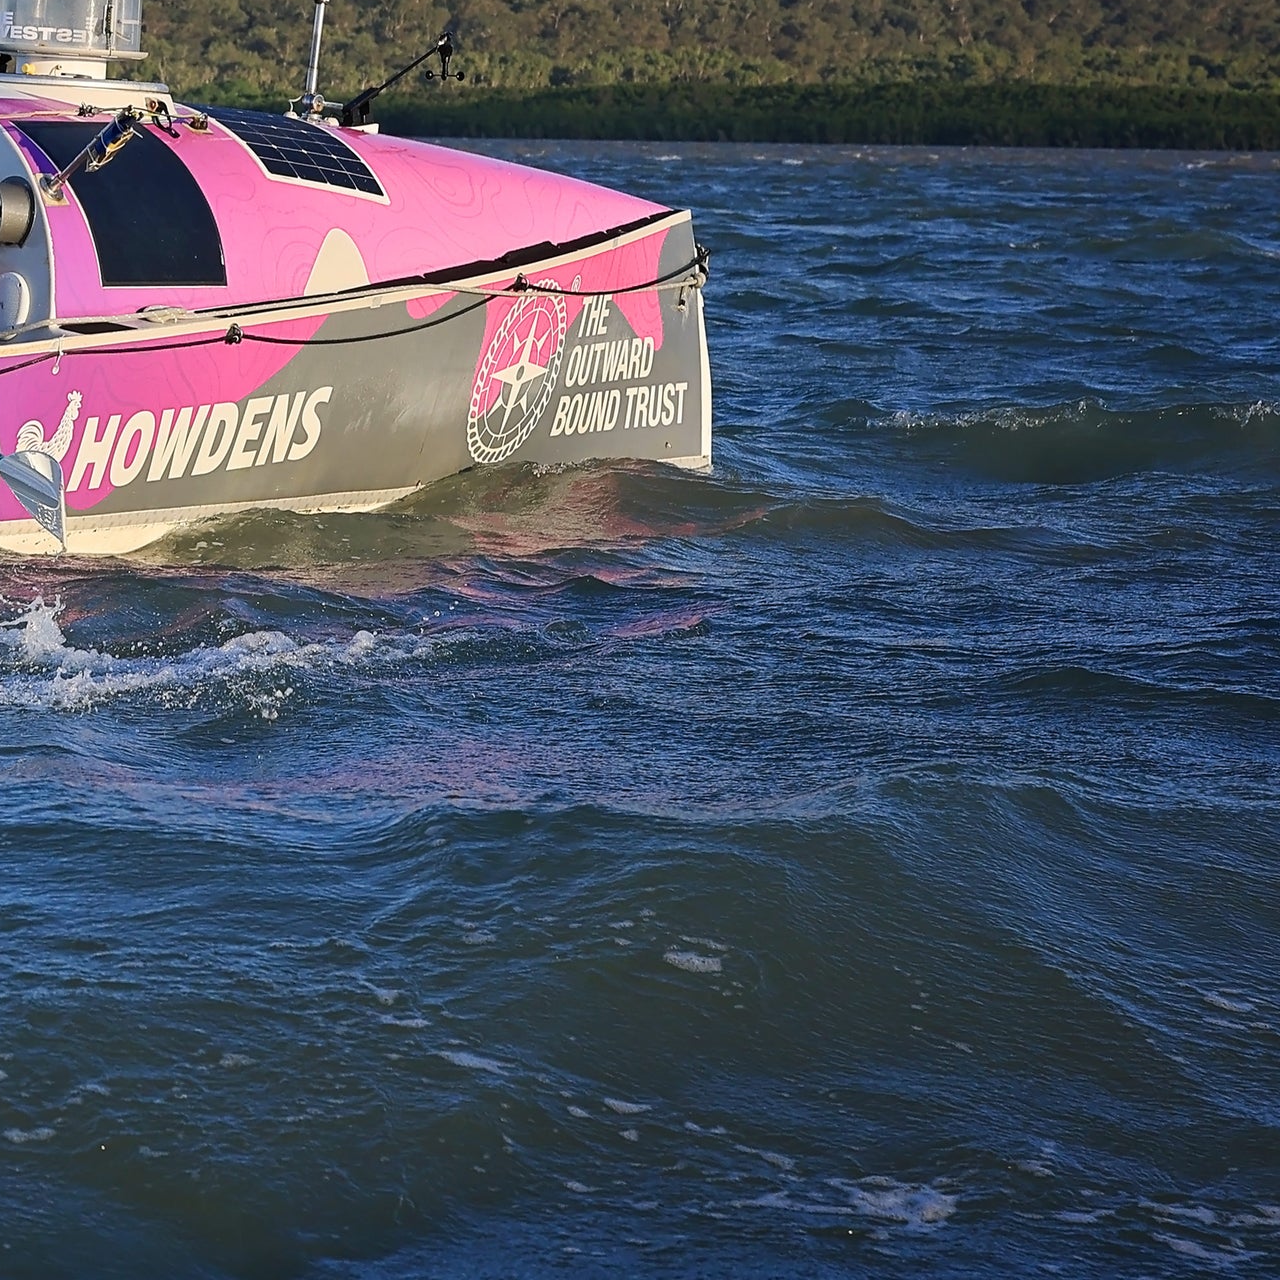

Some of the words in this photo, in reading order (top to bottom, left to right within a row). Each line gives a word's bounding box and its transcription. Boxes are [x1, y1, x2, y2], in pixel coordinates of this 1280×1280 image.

[578, 294, 613, 338] THE
[565, 336, 655, 388] OUTWARD
[549, 389, 621, 437] BOUND
[624, 382, 688, 429] TRUST
[65, 386, 334, 492] HOWDENS
